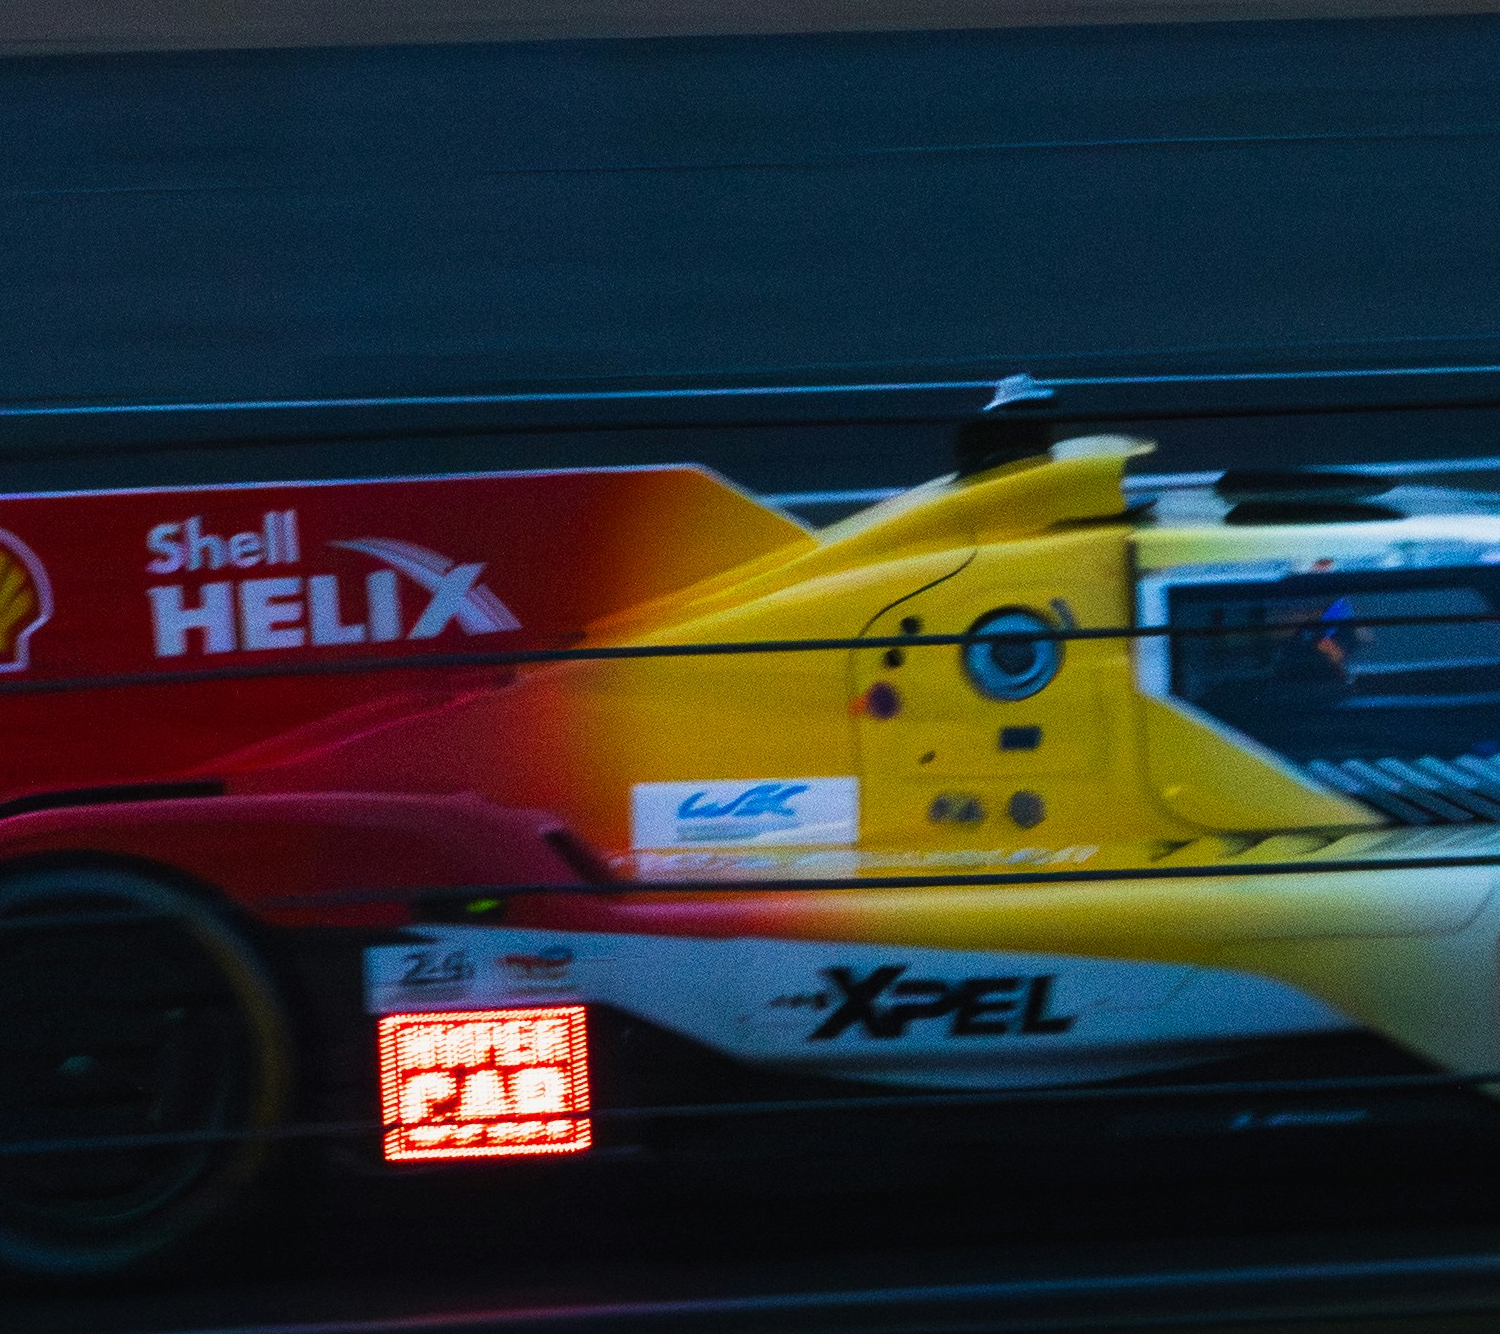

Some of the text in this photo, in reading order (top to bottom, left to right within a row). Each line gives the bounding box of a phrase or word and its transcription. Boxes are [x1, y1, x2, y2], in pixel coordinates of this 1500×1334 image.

[145, 508, 299, 574] Shell
[147, 547, 523, 658] HELIX
[804, 965, 1078, 1043] XPEL
